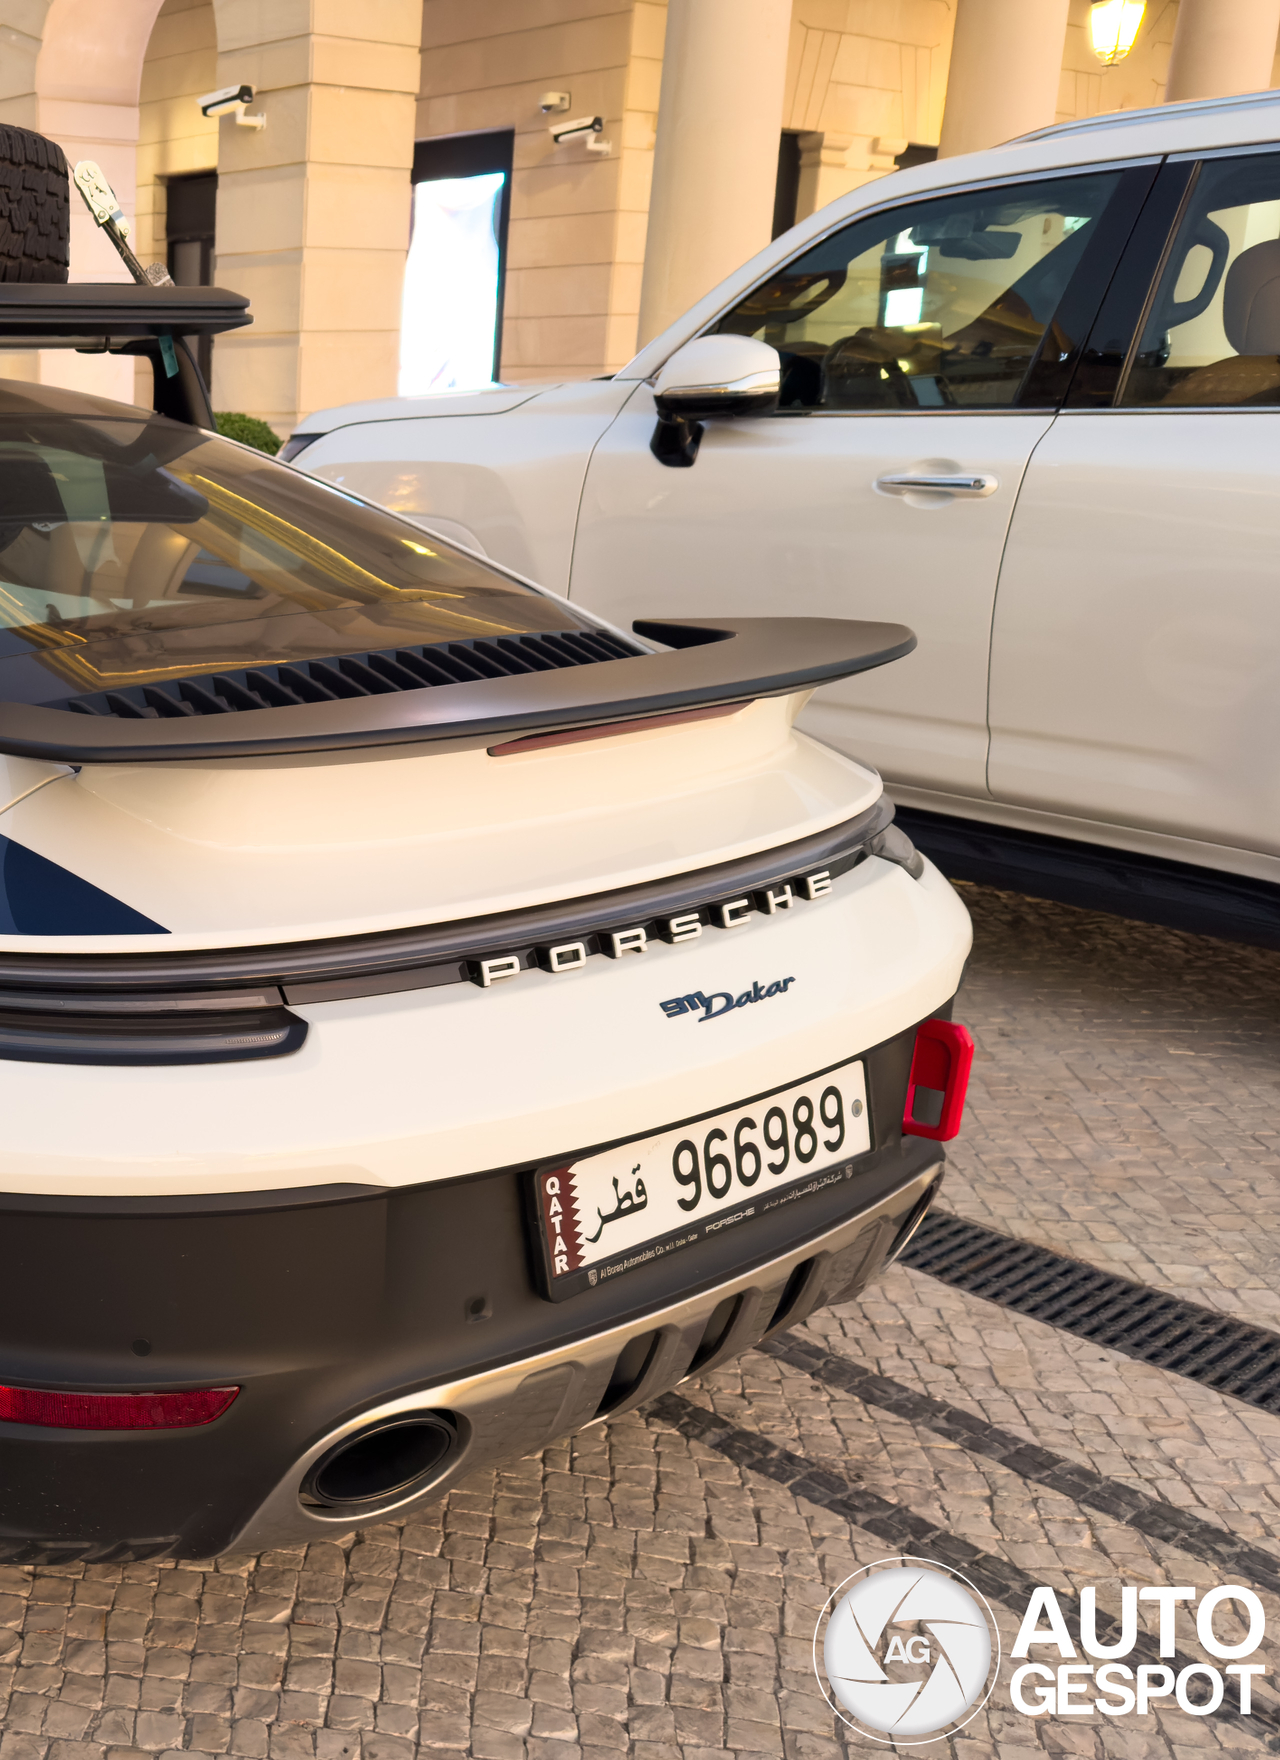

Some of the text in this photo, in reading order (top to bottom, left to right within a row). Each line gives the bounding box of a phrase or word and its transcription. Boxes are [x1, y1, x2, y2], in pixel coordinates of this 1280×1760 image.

[481, 871, 833, 987] PORSCHE
[698, 976, 796, 1023] Dakar
[672, 1085, 846, 1212] 966989
[545, 1175, 570, 1275] QATAR
[585, 1162, 648, 1244] قطر
[705, 1206, 755, 1234] PORSCHE
[623, 1249, 655, 1270] Automobiles
